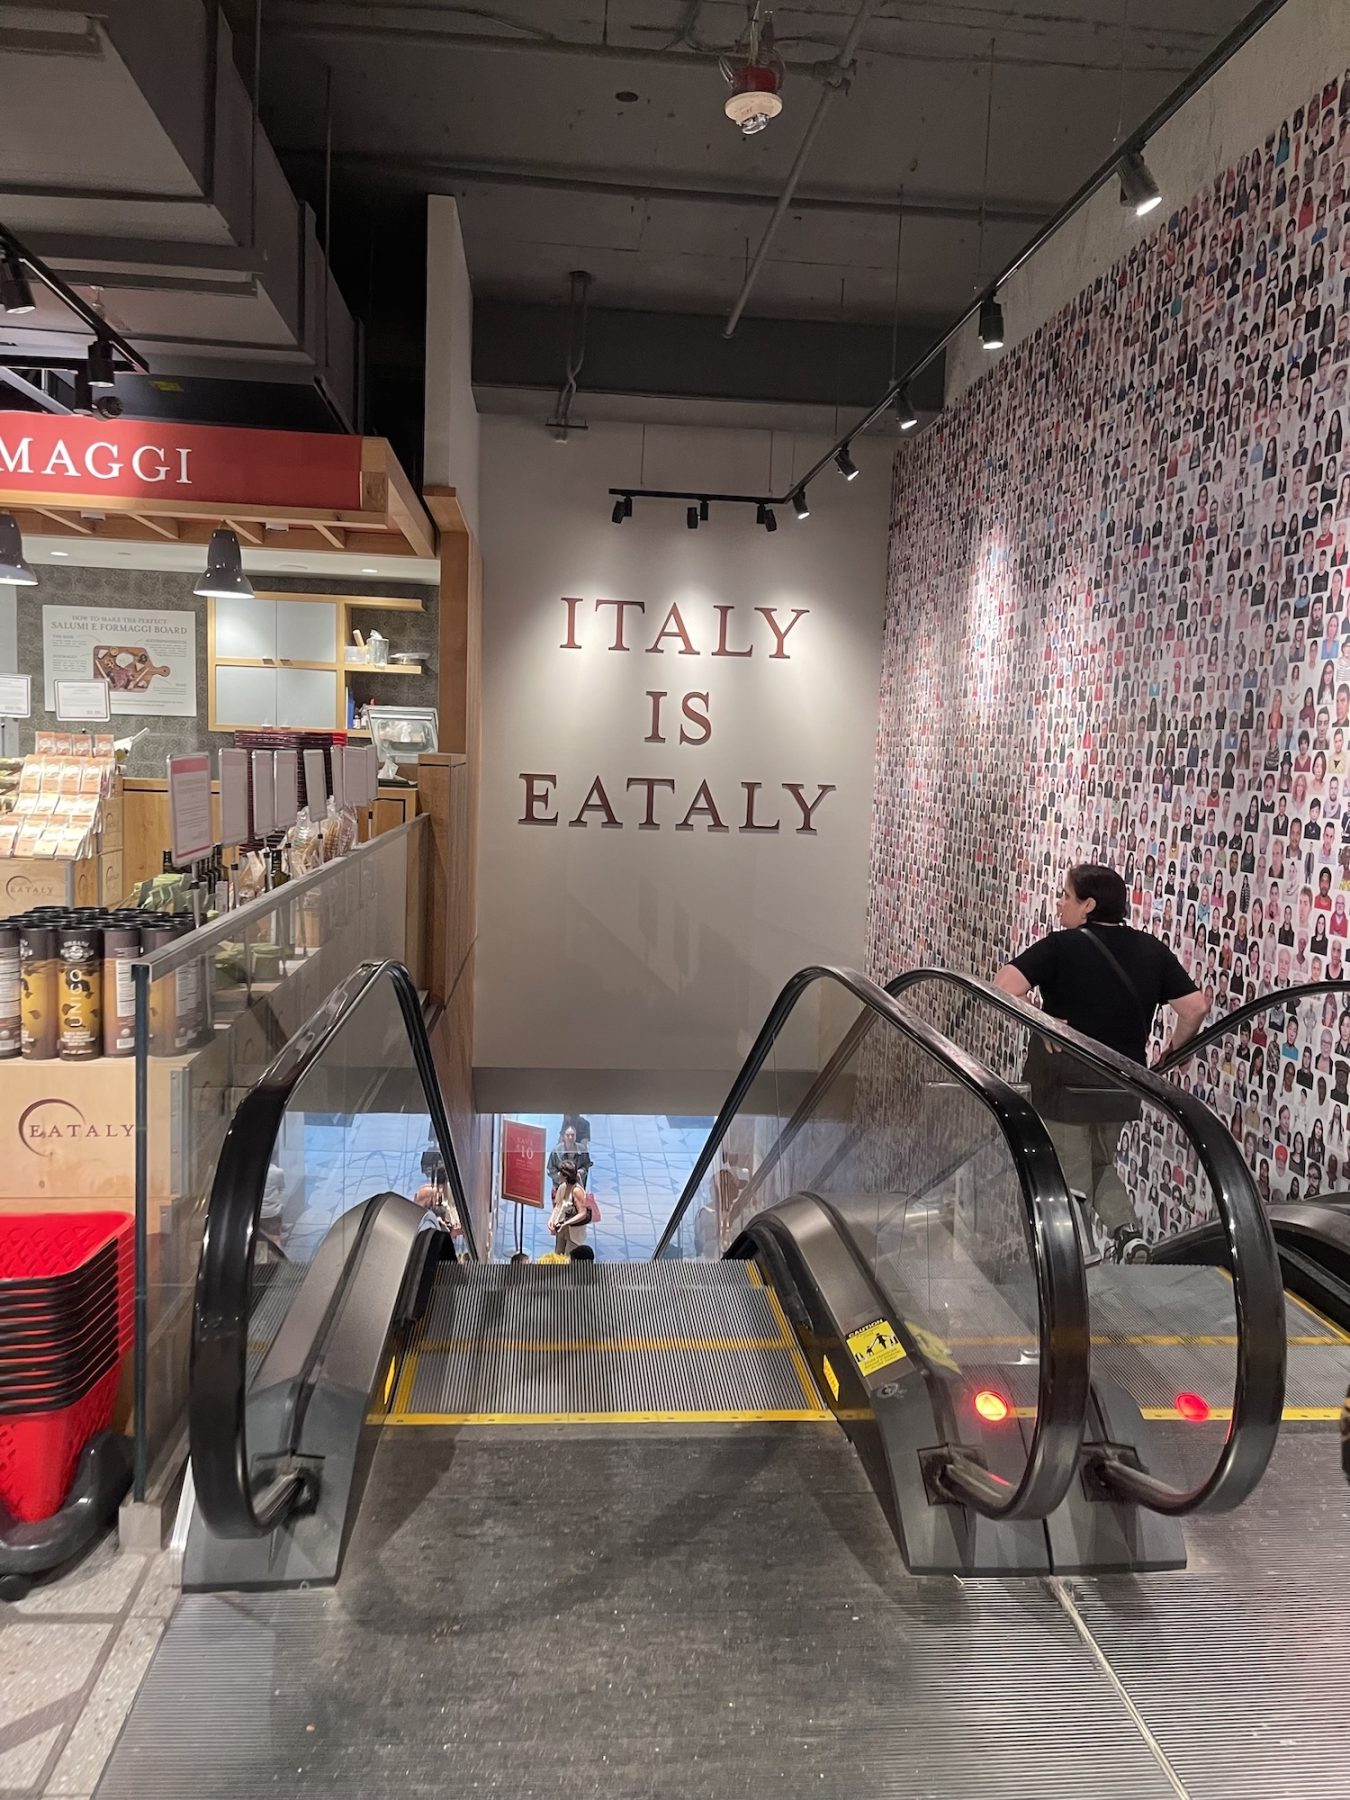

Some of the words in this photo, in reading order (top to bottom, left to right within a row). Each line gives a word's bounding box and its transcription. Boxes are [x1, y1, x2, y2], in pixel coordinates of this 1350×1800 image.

[0, 436, 193, 484] MAGGI
[51, 621, 89, 631] SALUMI
[92, 623, 98, 631] E
[100, 624, 152, 634] FORMAGGI
[154, 626, 187, 635] BOARD
[559, 596, 811, 659] ITALY
[643, 690, 713, 746] IS
[518, 773, 837, 835] EATALY
[10, 885, 55, 894] EATALY
[70, 969, 83, 1026] UNICO
[29, 1124, 135, 1138] EATALY
[848, 1318, 884, 1338] CAUTION
